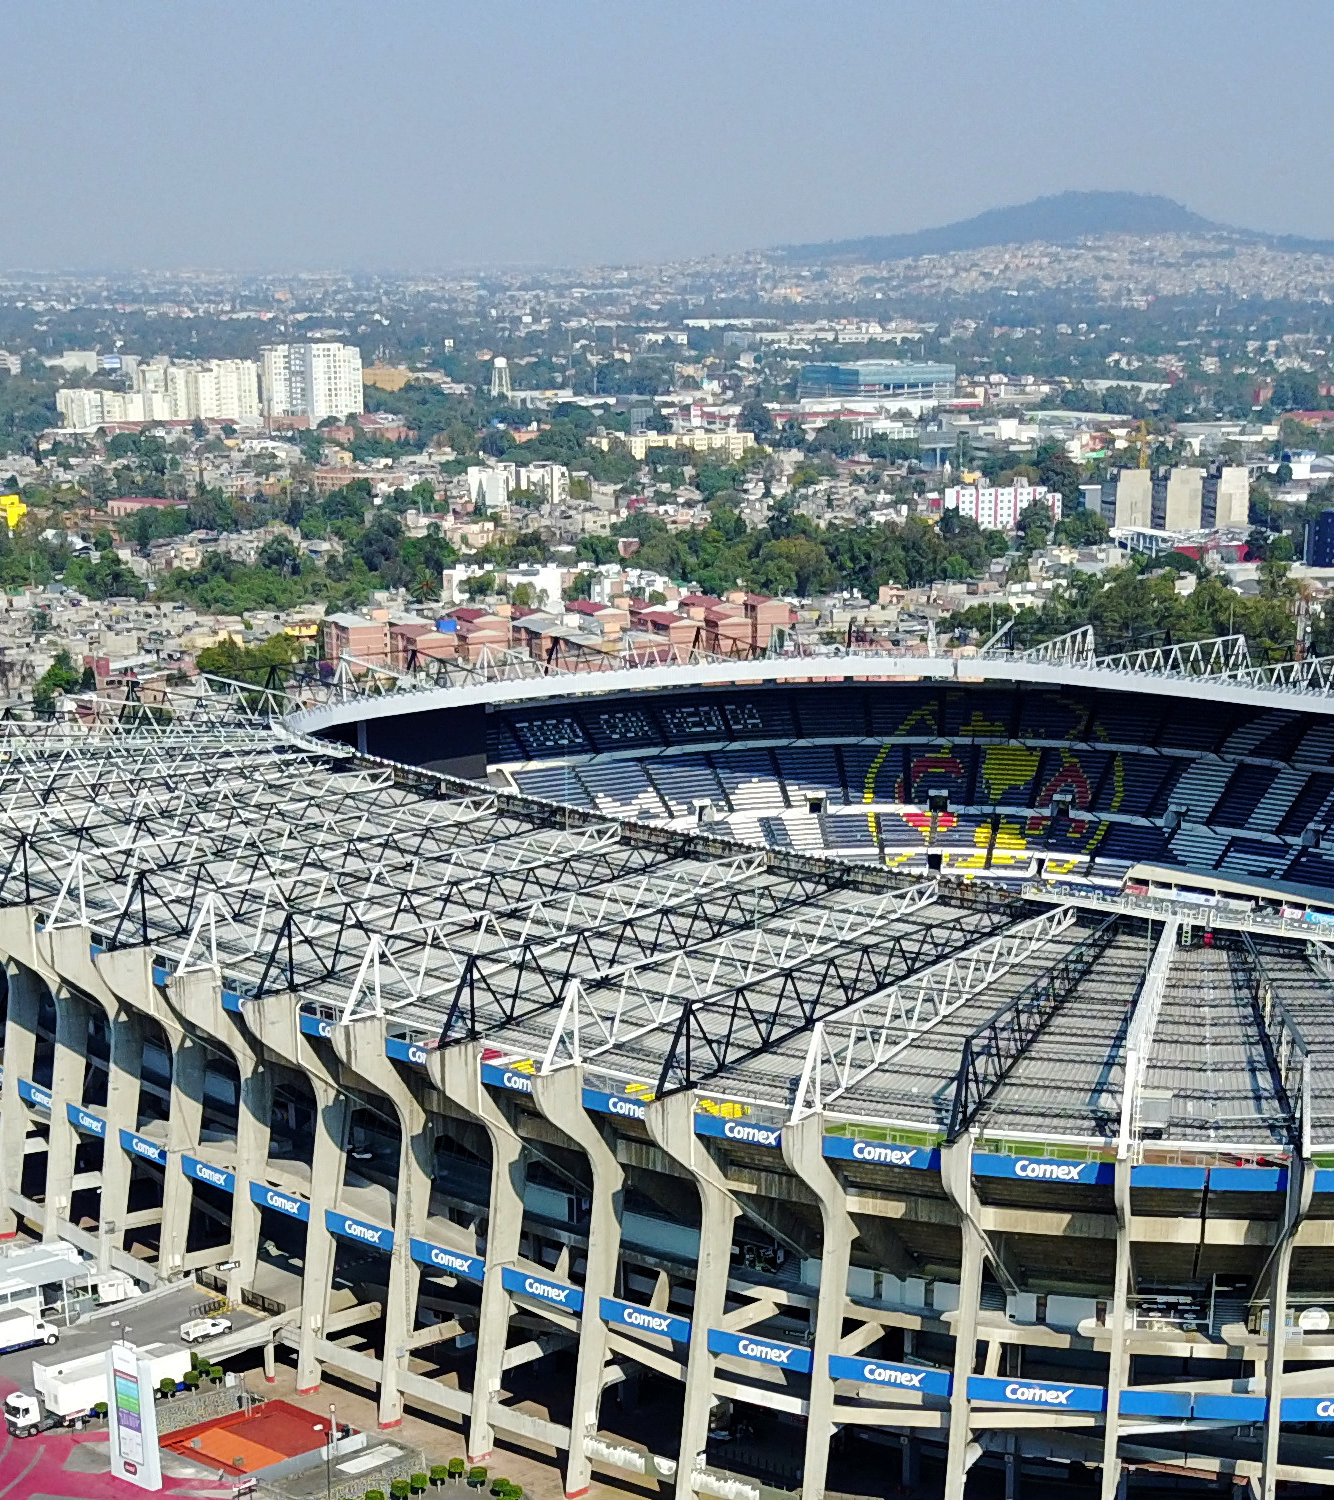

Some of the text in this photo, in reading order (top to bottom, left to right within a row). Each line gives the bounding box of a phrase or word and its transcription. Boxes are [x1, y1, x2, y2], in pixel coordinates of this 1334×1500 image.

[79, 1112, 103, 1132] Comex
[724, 1122, 781, 1146] Comex
[133, 1138, 160, 1159] Comex
[853, 1143, 916, 1165] Comex
[196, 1164, 226, 1186] Comex
[1015, 1160, 1086, 1180] Comex
[267, 1192, 299, 1214] Comex
[345, 1220, 381, 1243] Comex
[431, 1249, 471, 1272] Comex
[525, 1278, 569, 1303] Comex
[623, 1308, 671, 1332] Comex
[739, 1339, 793, 1364] Comex
[863, 1364, 926, 1388] Comex
[1005, 1384, 1073, 1404] Comex
